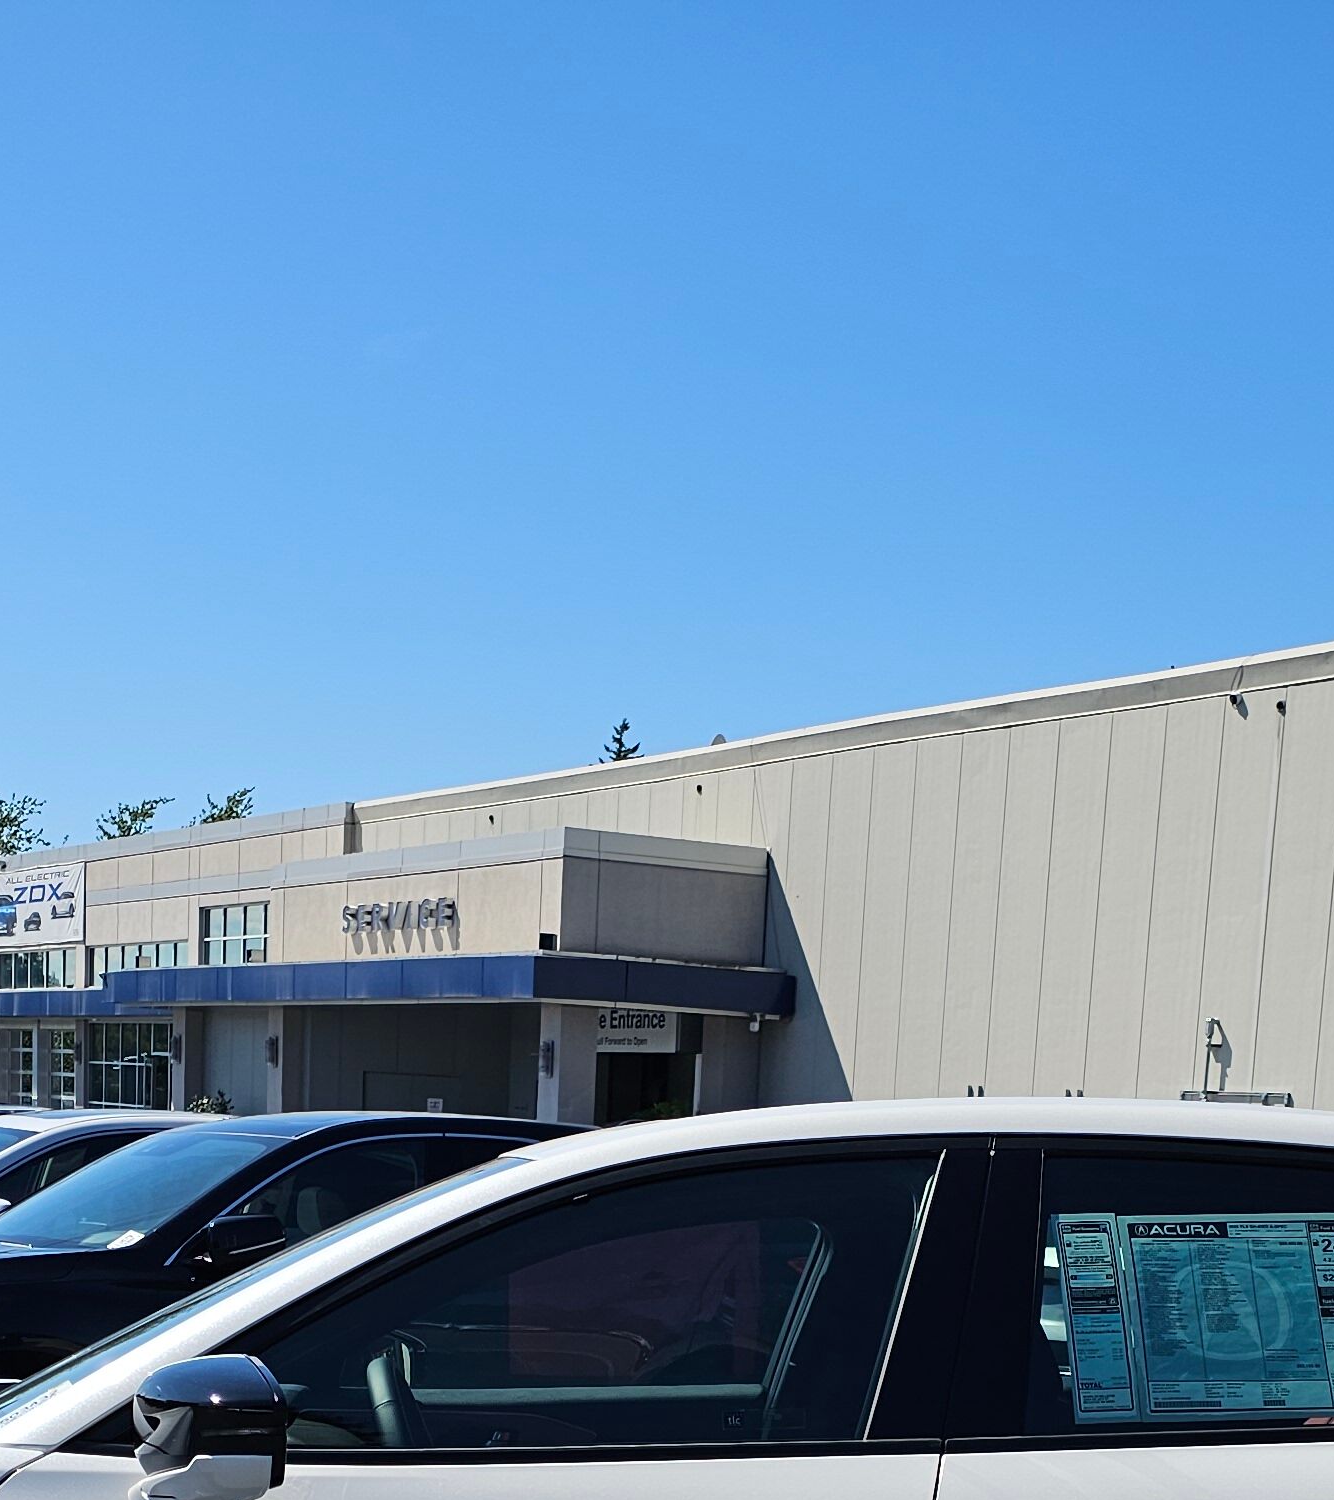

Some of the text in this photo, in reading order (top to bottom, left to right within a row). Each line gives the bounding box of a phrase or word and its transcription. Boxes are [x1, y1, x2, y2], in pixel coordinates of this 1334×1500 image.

[6, 870, 70, 885] ALL ELECTRIC
[14, 882, 63, 904] ZDX
[342, 897, 455, 934] SERVICE
[610, 1009, 666, 1029] Entrance
[1149, 1224, 1221, 1236] ACURA
